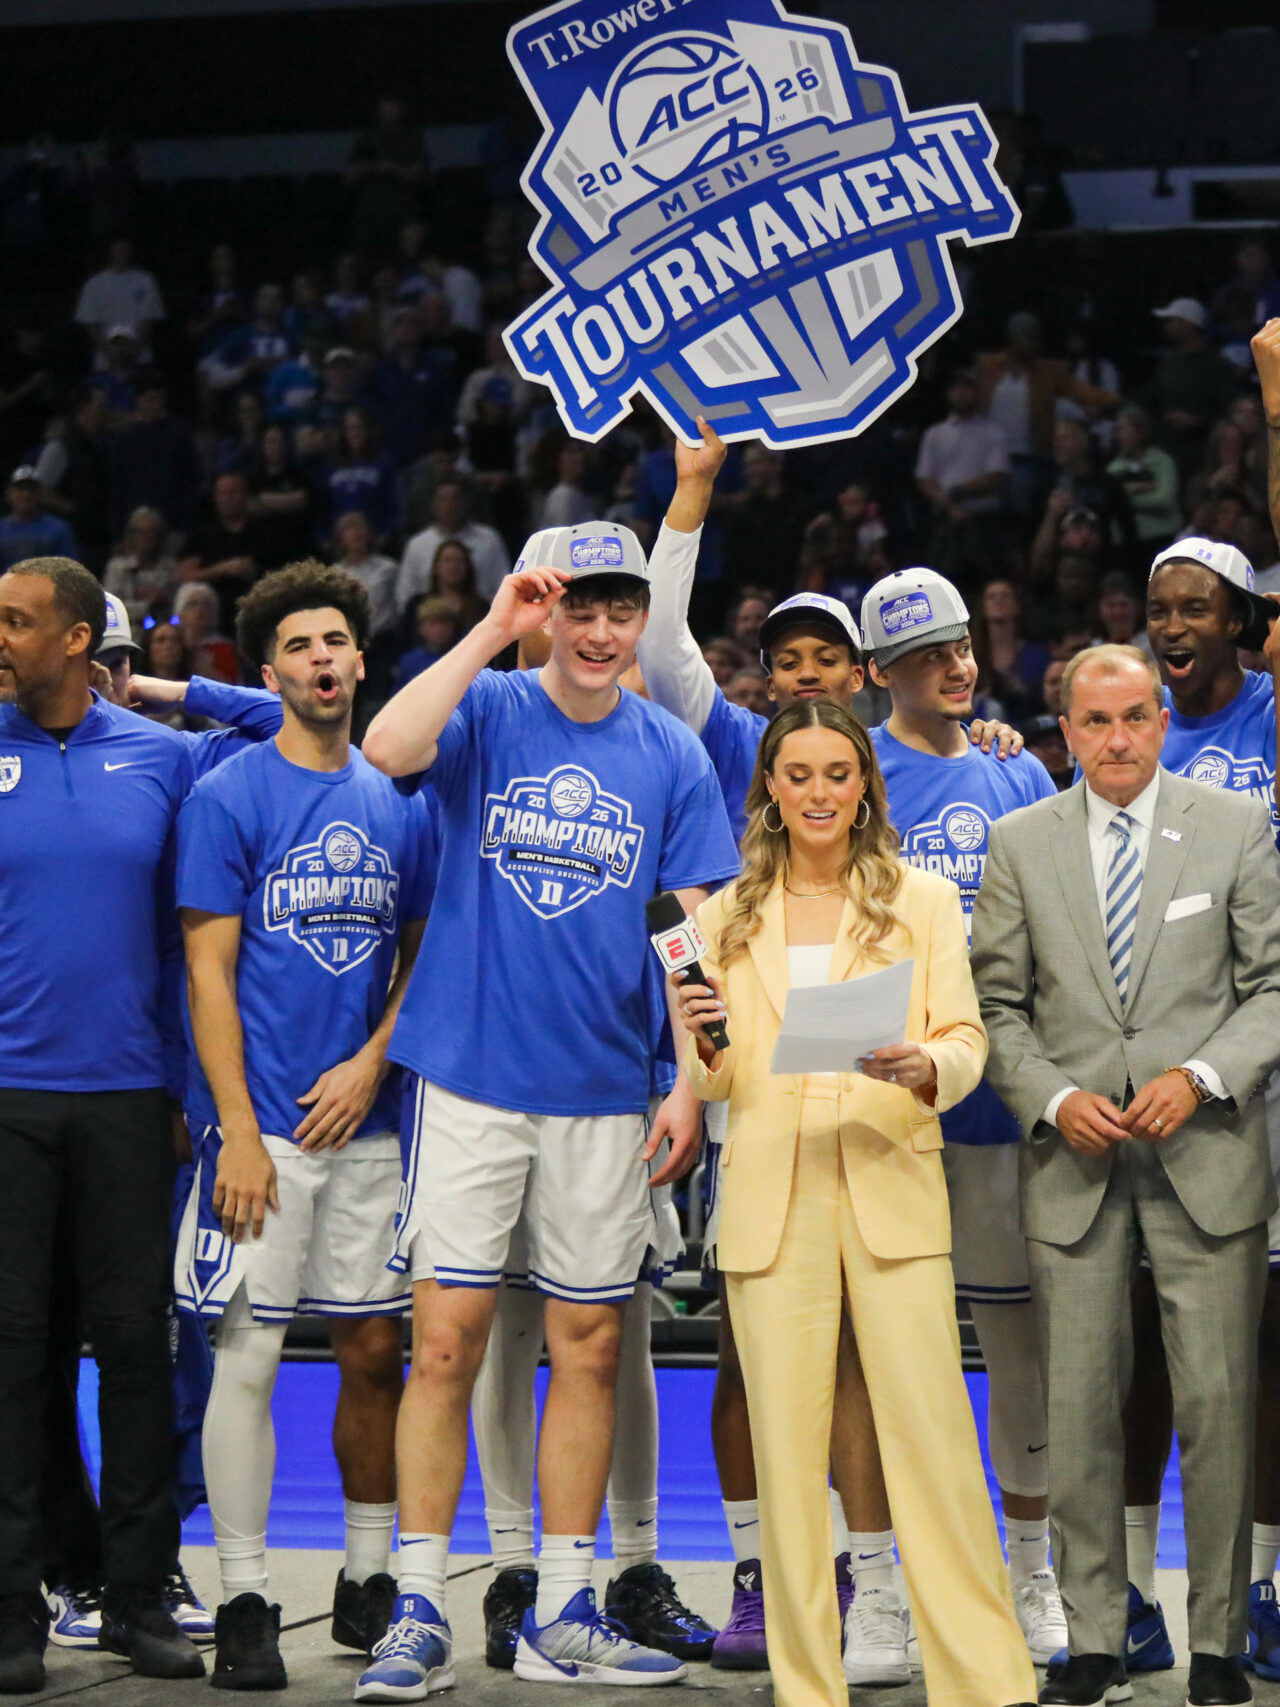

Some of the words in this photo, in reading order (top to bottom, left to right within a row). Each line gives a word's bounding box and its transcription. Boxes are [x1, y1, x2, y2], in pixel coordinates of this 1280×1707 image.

[774, 67, 819, 102] 26
[635, 58, 750, 147] ACC
[577, 161, 623, 197] 20
[658, 143, 791, 222] MEN'S
[522, 118, 994, 409] TOURNAMENT
[1232, 773, 1250, 787] 26
[527, 795, 546, 809] 20
[557, 789, 588, 800] ACC
[590, 809, 609, 822] 26
[953, 824, 981, 832] ACC
[485, 805, 637, 875] CHAMPIONS
[928, 838, 945, 849] 20
[307, 861, 324, 871] 20
[364, 861, 376, 871] 26
[516, 851, 543, 862] MEN'S
[544, 855, 596, 873] BASKETBALL
[272, 876, 397, 921] CHAMPIONS
